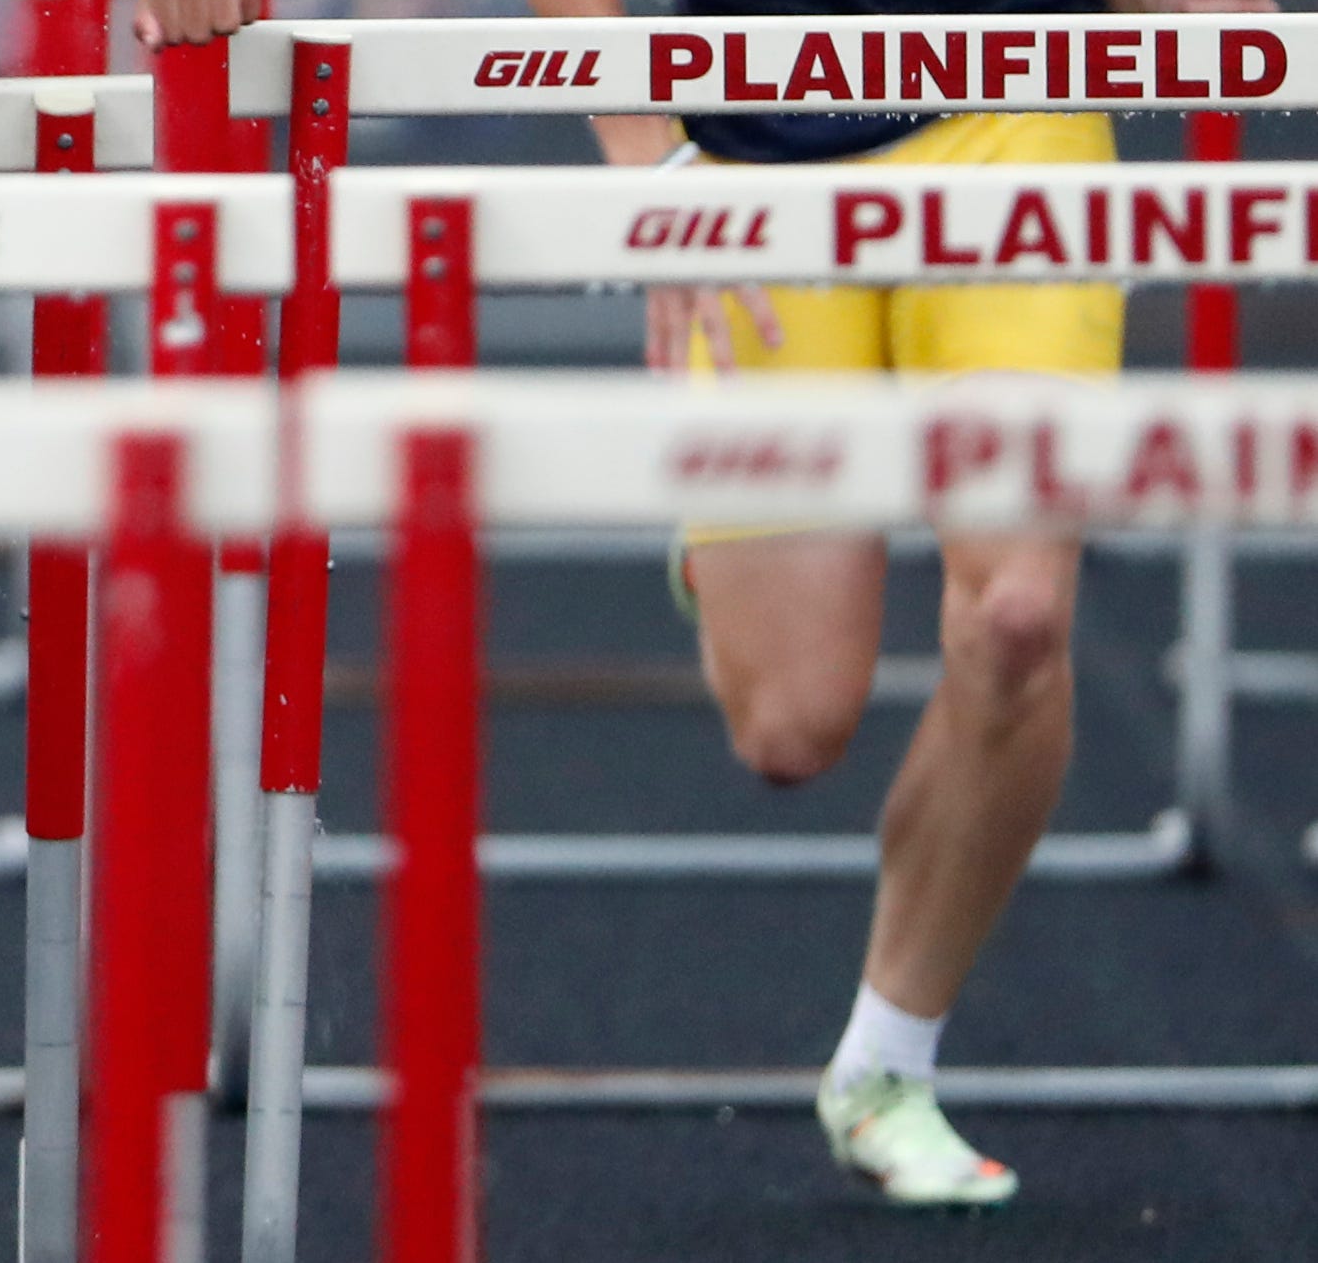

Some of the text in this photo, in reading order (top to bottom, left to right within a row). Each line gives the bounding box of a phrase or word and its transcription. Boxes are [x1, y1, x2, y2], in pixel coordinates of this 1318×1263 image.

[475, 29, 1287, 102] GILL PLAINFIELD
[625, 209, 768, 251] GILL
